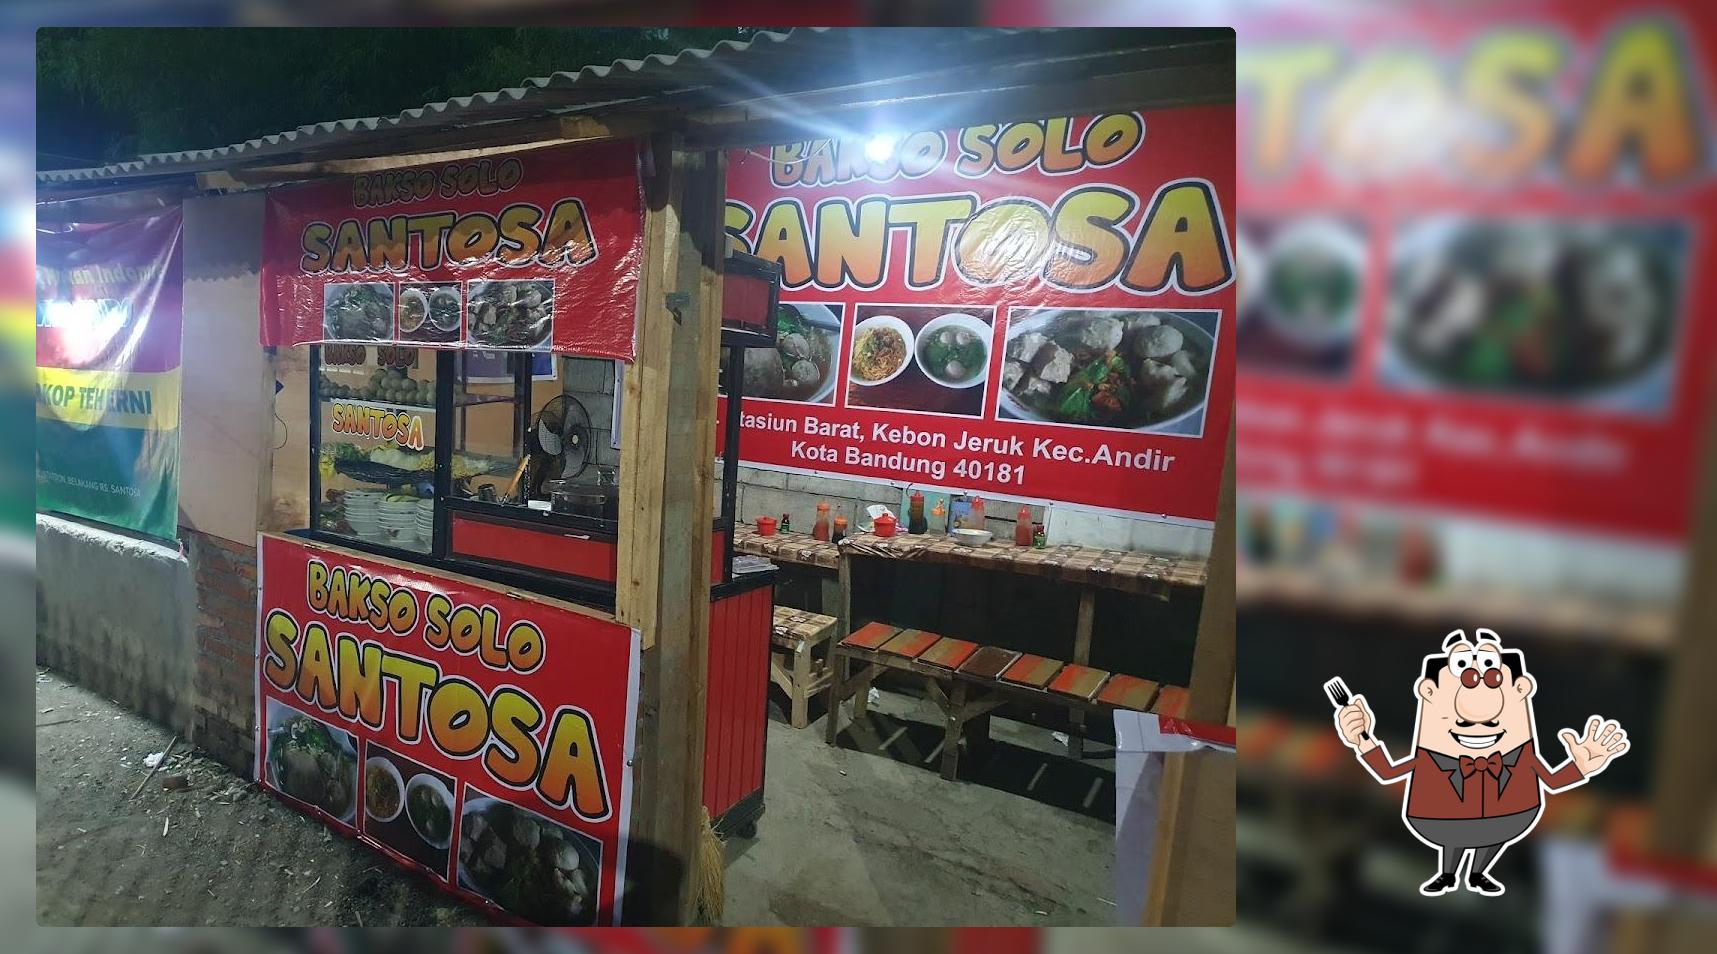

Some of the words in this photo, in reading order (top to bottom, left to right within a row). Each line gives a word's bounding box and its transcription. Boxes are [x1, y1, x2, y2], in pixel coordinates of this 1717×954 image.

[954, 111, 1147, 179] SOLO
[354, 169, 436, 208] BAKSO
[440, 157, 523, 200] SOLO
[300, 198, 598, 275] SANTOSA
[332, 402, 425, 451] SANTOSA
[740, 411, 797, 433] tasiun
[804, 416, 865, 442] Barat,
[872, 422, 946, 449] Kebon
[953, 430, 1025, 457] Jeruk
[1032, 438, 1177, 472] Kec.Andir
[791, 440, 838, 464] Kota
[844, 446, 946, 480] Bandung
[952, 459, 1025, 486] 40181
[308, 559, 418, 636] BAKSO
[425, 593, 545, 675] SOLO
[261, 607, 613, 824] SANTOSA
